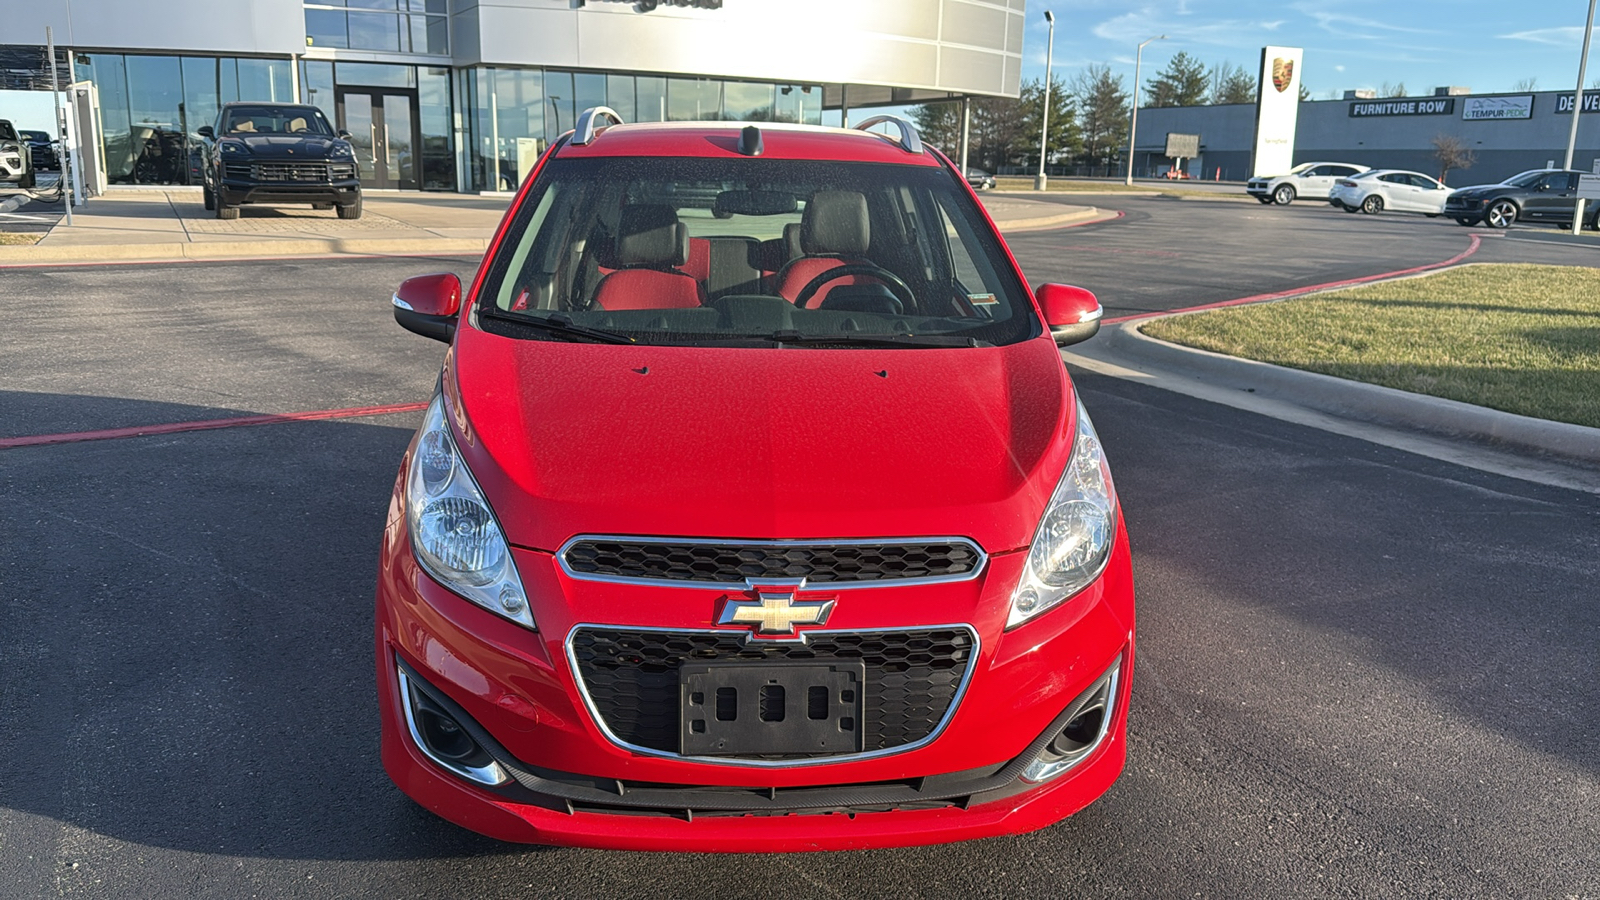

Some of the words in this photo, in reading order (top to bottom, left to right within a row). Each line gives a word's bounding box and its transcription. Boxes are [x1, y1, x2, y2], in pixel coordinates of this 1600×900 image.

[1354, 102, 1416, 115] FURNITURE
[1418, 101, 1447, 113] ROW
[1471, 109, 1528, 118] TEMPUR-PEDIC
